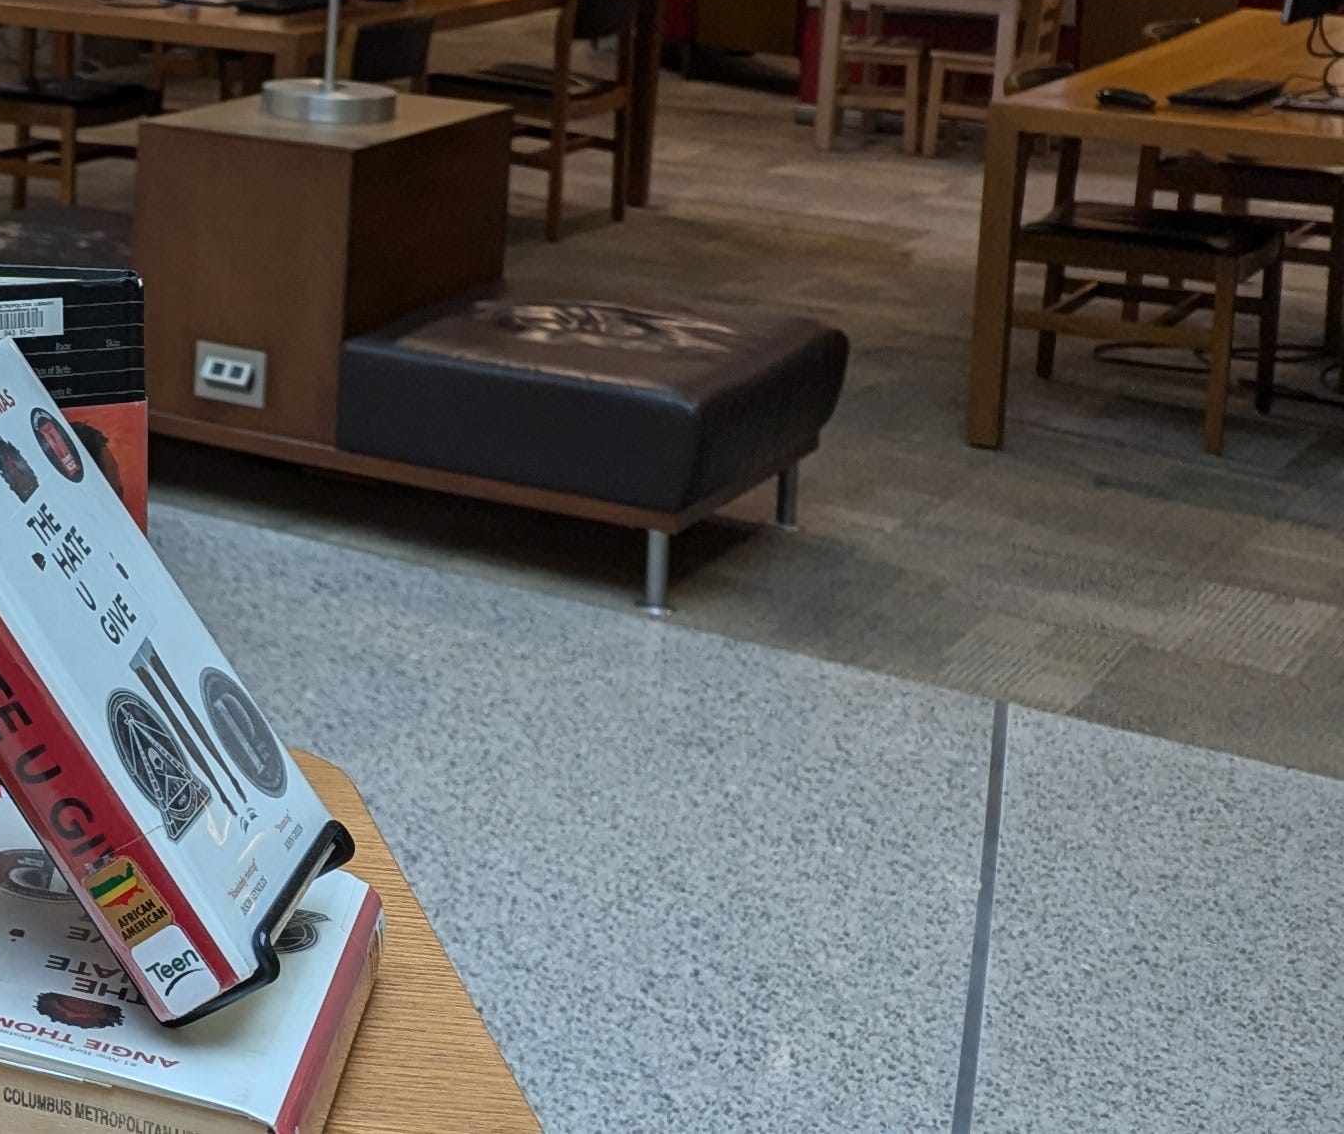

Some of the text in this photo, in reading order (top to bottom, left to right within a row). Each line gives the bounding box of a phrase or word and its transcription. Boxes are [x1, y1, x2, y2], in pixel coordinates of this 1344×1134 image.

[26, 502, 62, 547] THE
[51, 525, 92, 581] HATE
[75, 580, 97, 612] U
[99, 593, 137, 646] GIVE
[15, 743, 62, 786] U
[117, 899, 156, 929] AFRICAN
[120, 906, 168, 942] AMERICAN
[145, 949, 200, 983] Teen
[83, 1038, 180, 1069] ANGIE
[3, 1086, 73, 1117] COLUMBUS
